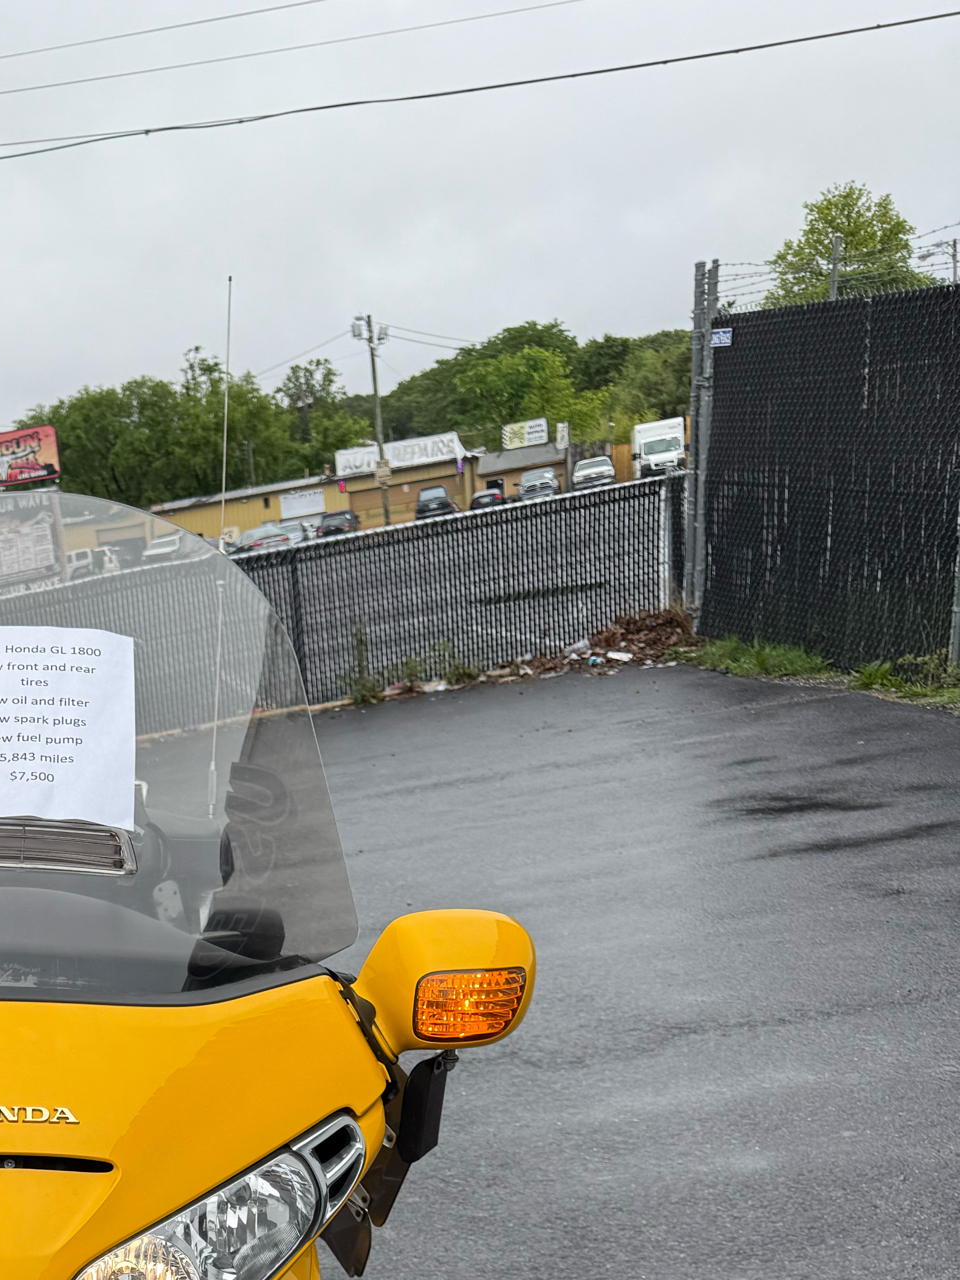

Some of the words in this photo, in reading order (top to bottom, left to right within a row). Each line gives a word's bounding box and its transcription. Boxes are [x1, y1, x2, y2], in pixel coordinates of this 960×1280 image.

[5, 644, 45, 653] Honda
[50, 645, 66, 654] GL
[70, 646, 101, 656] 1800
[6, 661, 38, 670] front
[42, 662, 66, 671] and
[70, 665, 96, 674] rear
[20, 677, 48, 686] tires
[11, 695, 27, 704] oil
[30, 696, 54, 705] and
[58, 697, 89, 707] filter
[13, 715, 48, 724] spark
[52, 716, 86, 727] plugs
[16, 733, 41, 742] fuel
[45, 736, 83, 746] pump
[40, 754, 74, 763] miles
[9, 770, 54, 782] $7,500
